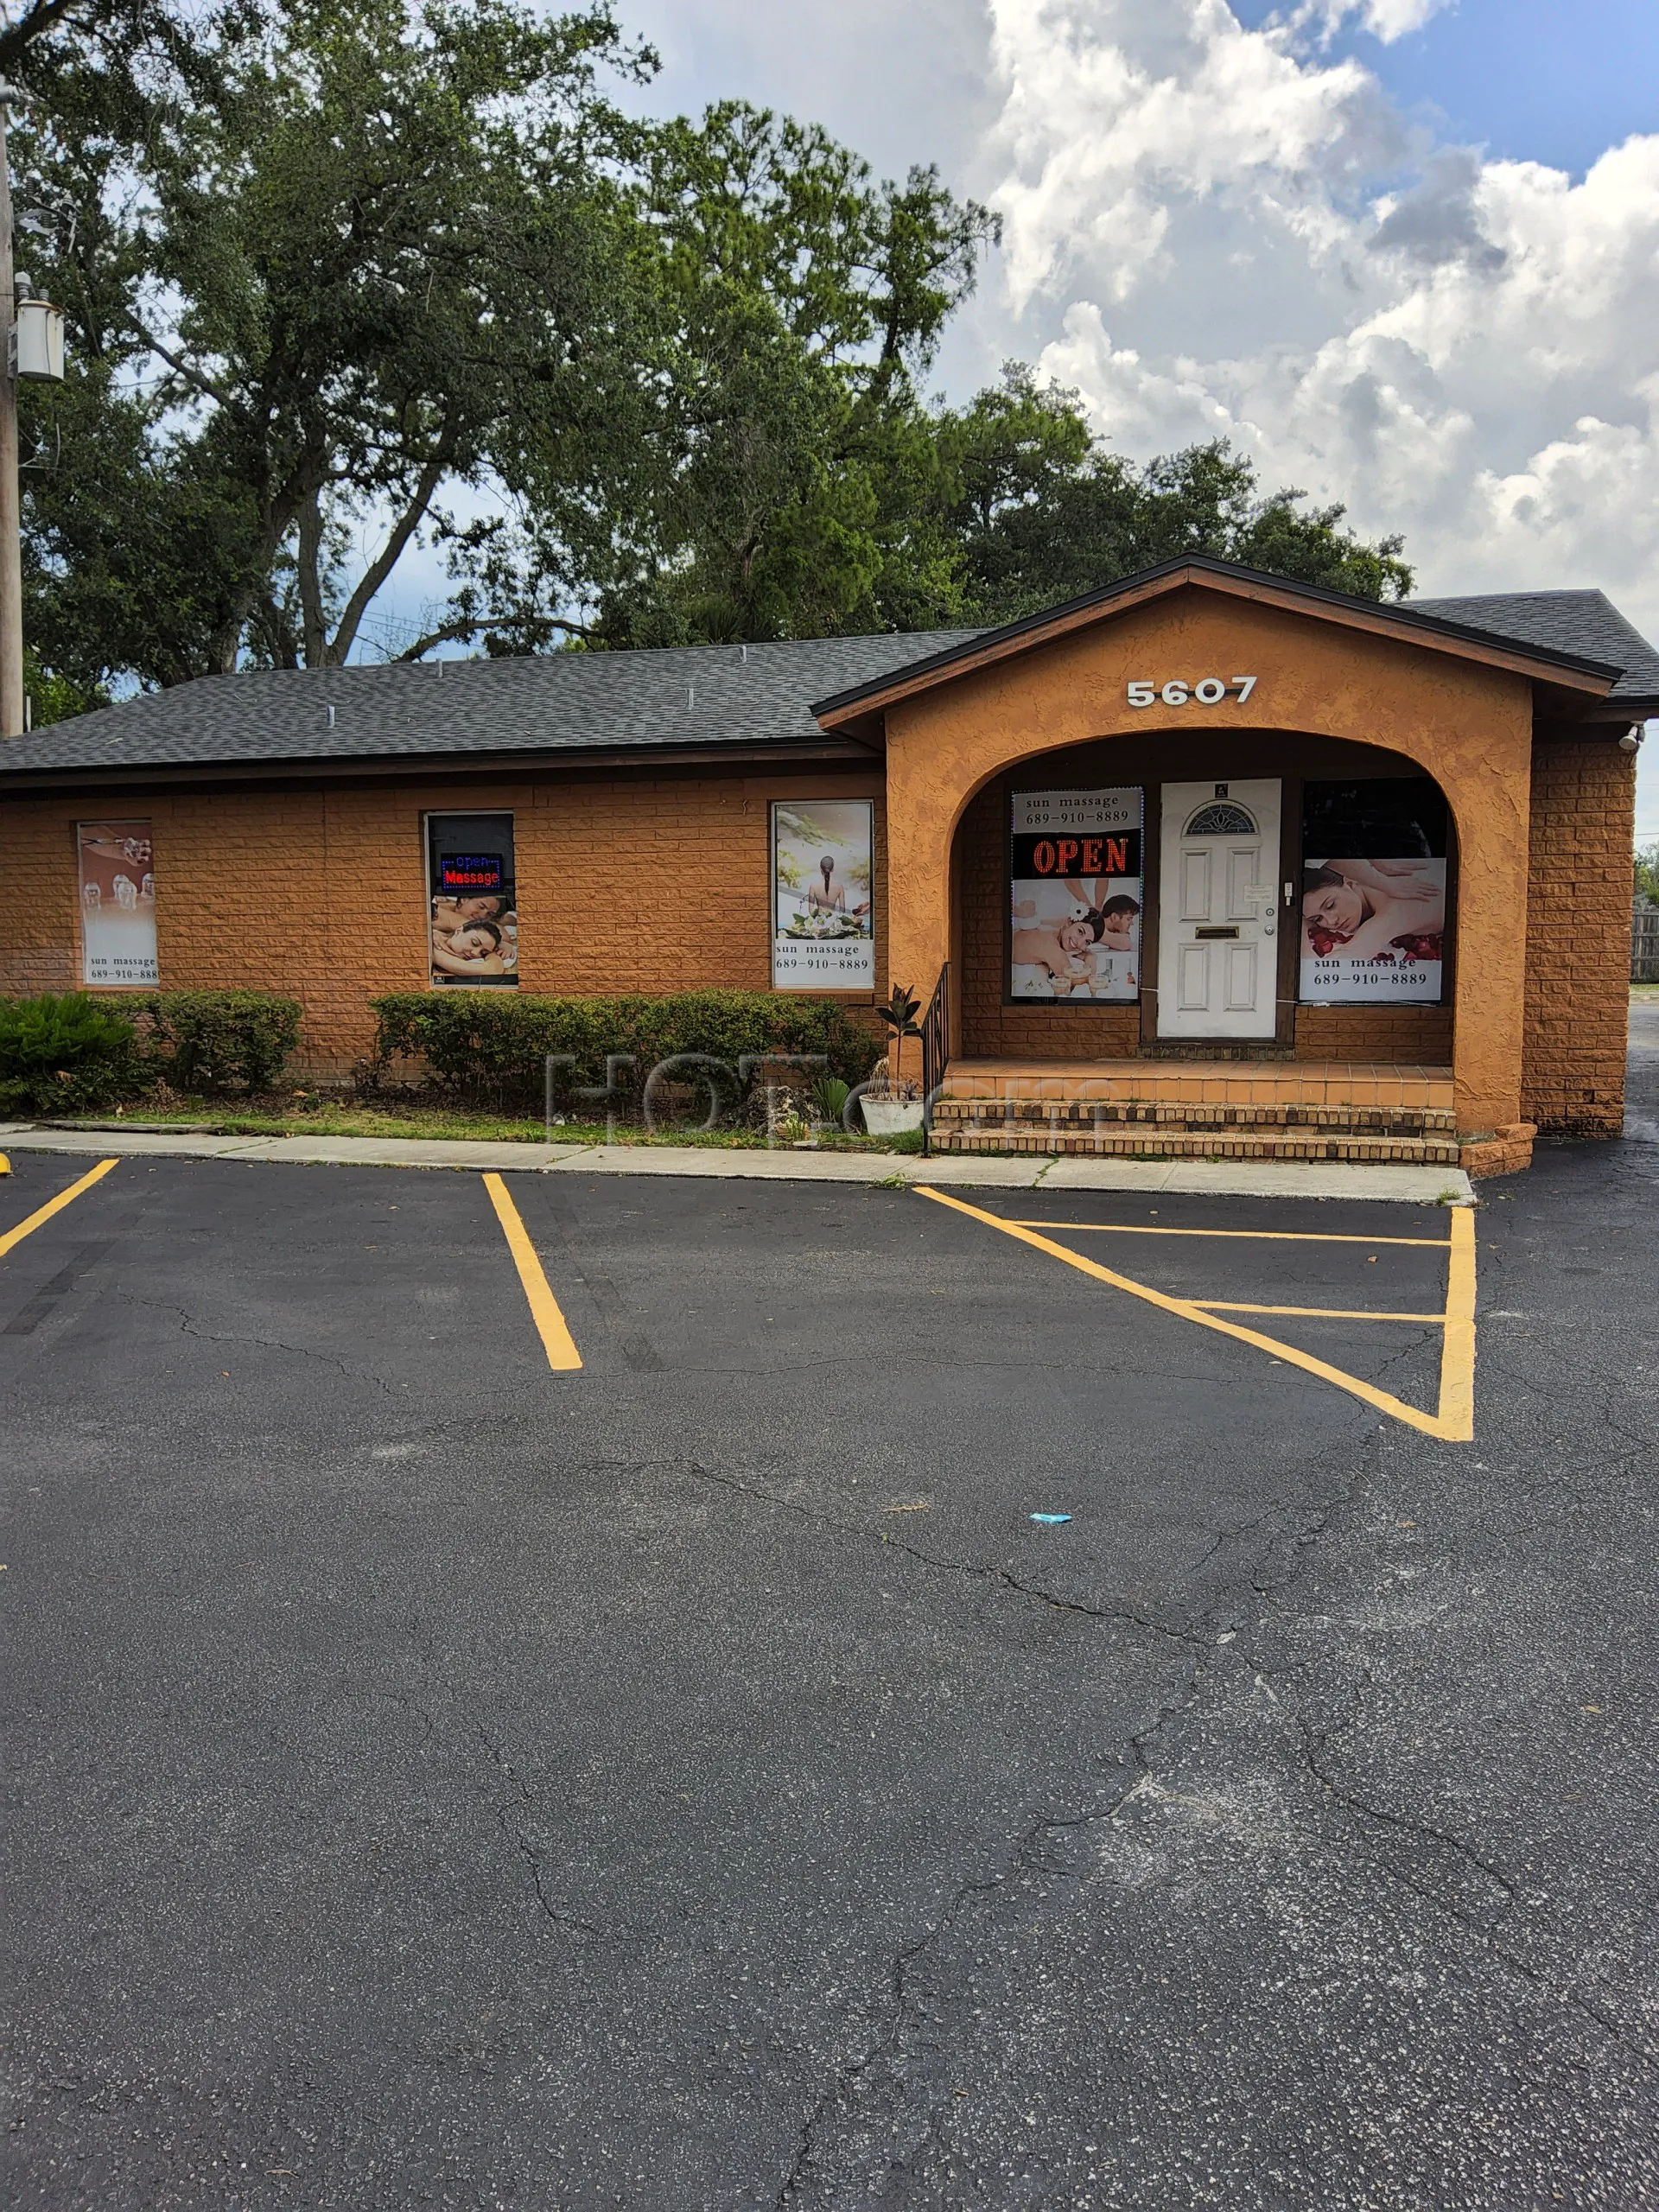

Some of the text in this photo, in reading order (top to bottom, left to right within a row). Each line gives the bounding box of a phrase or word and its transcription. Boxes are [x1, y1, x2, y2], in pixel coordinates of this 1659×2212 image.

[1127, 676, 1258, 708] 5607
[1026, 797, 1119, 809] sun massage
[1026, 810, 1128, 824] 689-910-8889
[1033, 838, 1129, 874] OPEN
[444, 870, 499, 886] Massage
[776, 945, 860, 957] sun massage
[113, 957, 156, 968] massage
[776, 958, 868, 969] 689-910-8889
[1314, 958, 1417, 970] sun massage
[1313, 973, 1427, 985] 689-910-8889
